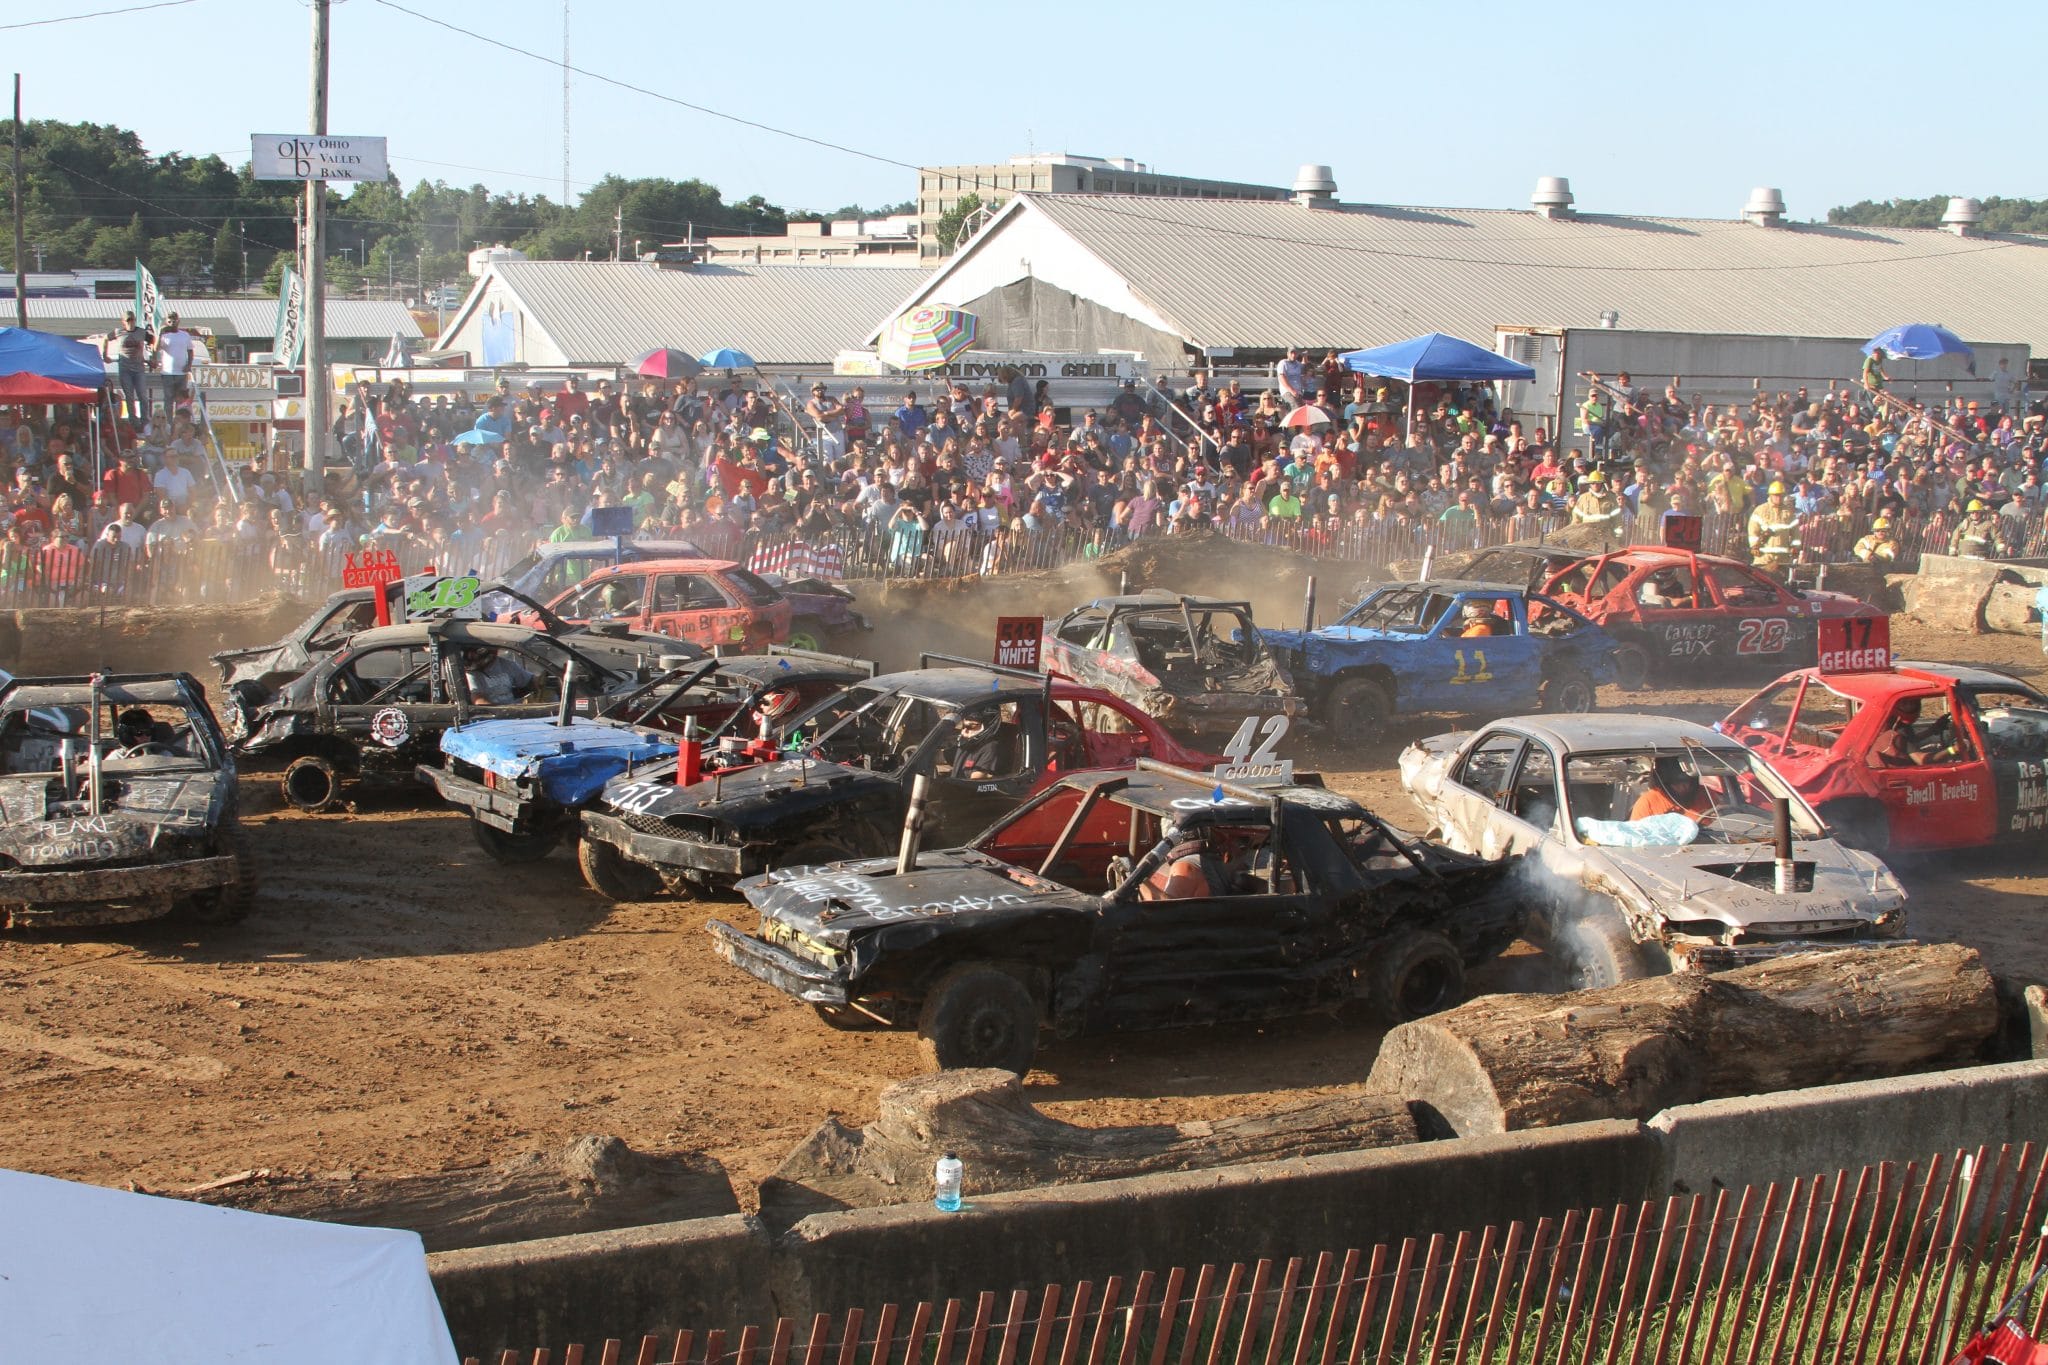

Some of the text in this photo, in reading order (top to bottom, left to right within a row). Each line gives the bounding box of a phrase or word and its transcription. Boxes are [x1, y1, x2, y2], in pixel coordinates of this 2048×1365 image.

[433, 577, 480, 608] 13
[1000, 623, 1036, 648] 513
[1843, 618, 1873, 651] 17
[999, 647, 1036, 665] WHITE
[1449, 649, 1494, 685] 11
[1821, 647, 1888, 671] GEIGER
[1222, 714, 1290, 765] 42
[1224, 763, 1284, 780] GOODE
[609, 781, 674, 816] 513
